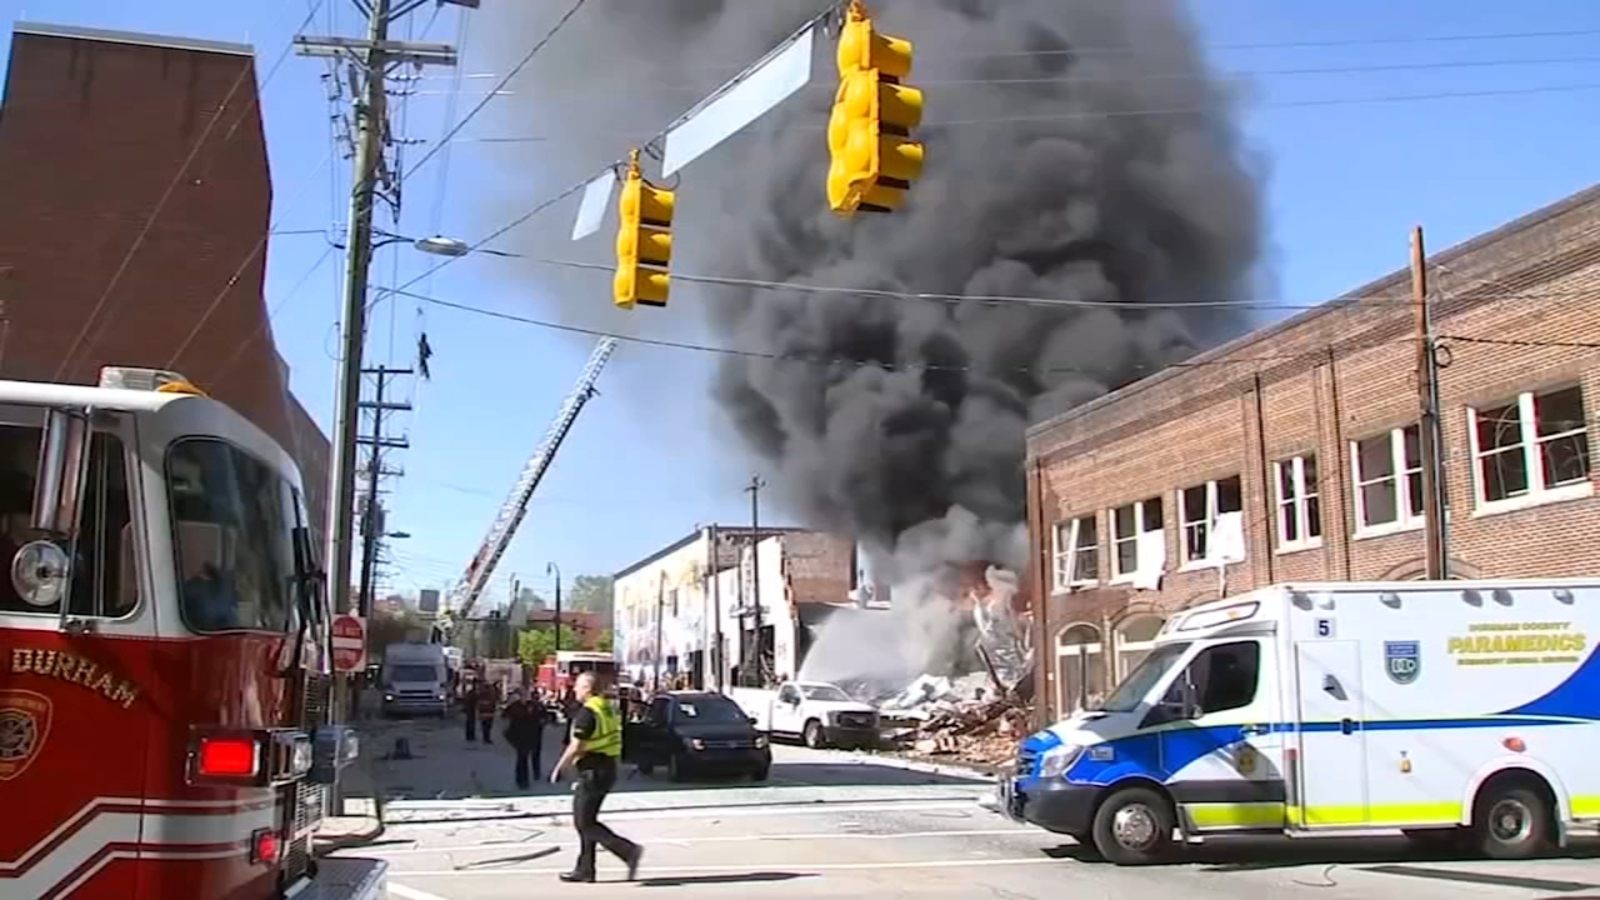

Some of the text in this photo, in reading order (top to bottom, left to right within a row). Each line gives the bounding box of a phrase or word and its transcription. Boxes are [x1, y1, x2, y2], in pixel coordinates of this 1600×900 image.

[1319, 619, 1330, 636] 5
[1447, 633, 1586, 654] PARAMEDICS
[12, 648, 136, 709] DURHAM
